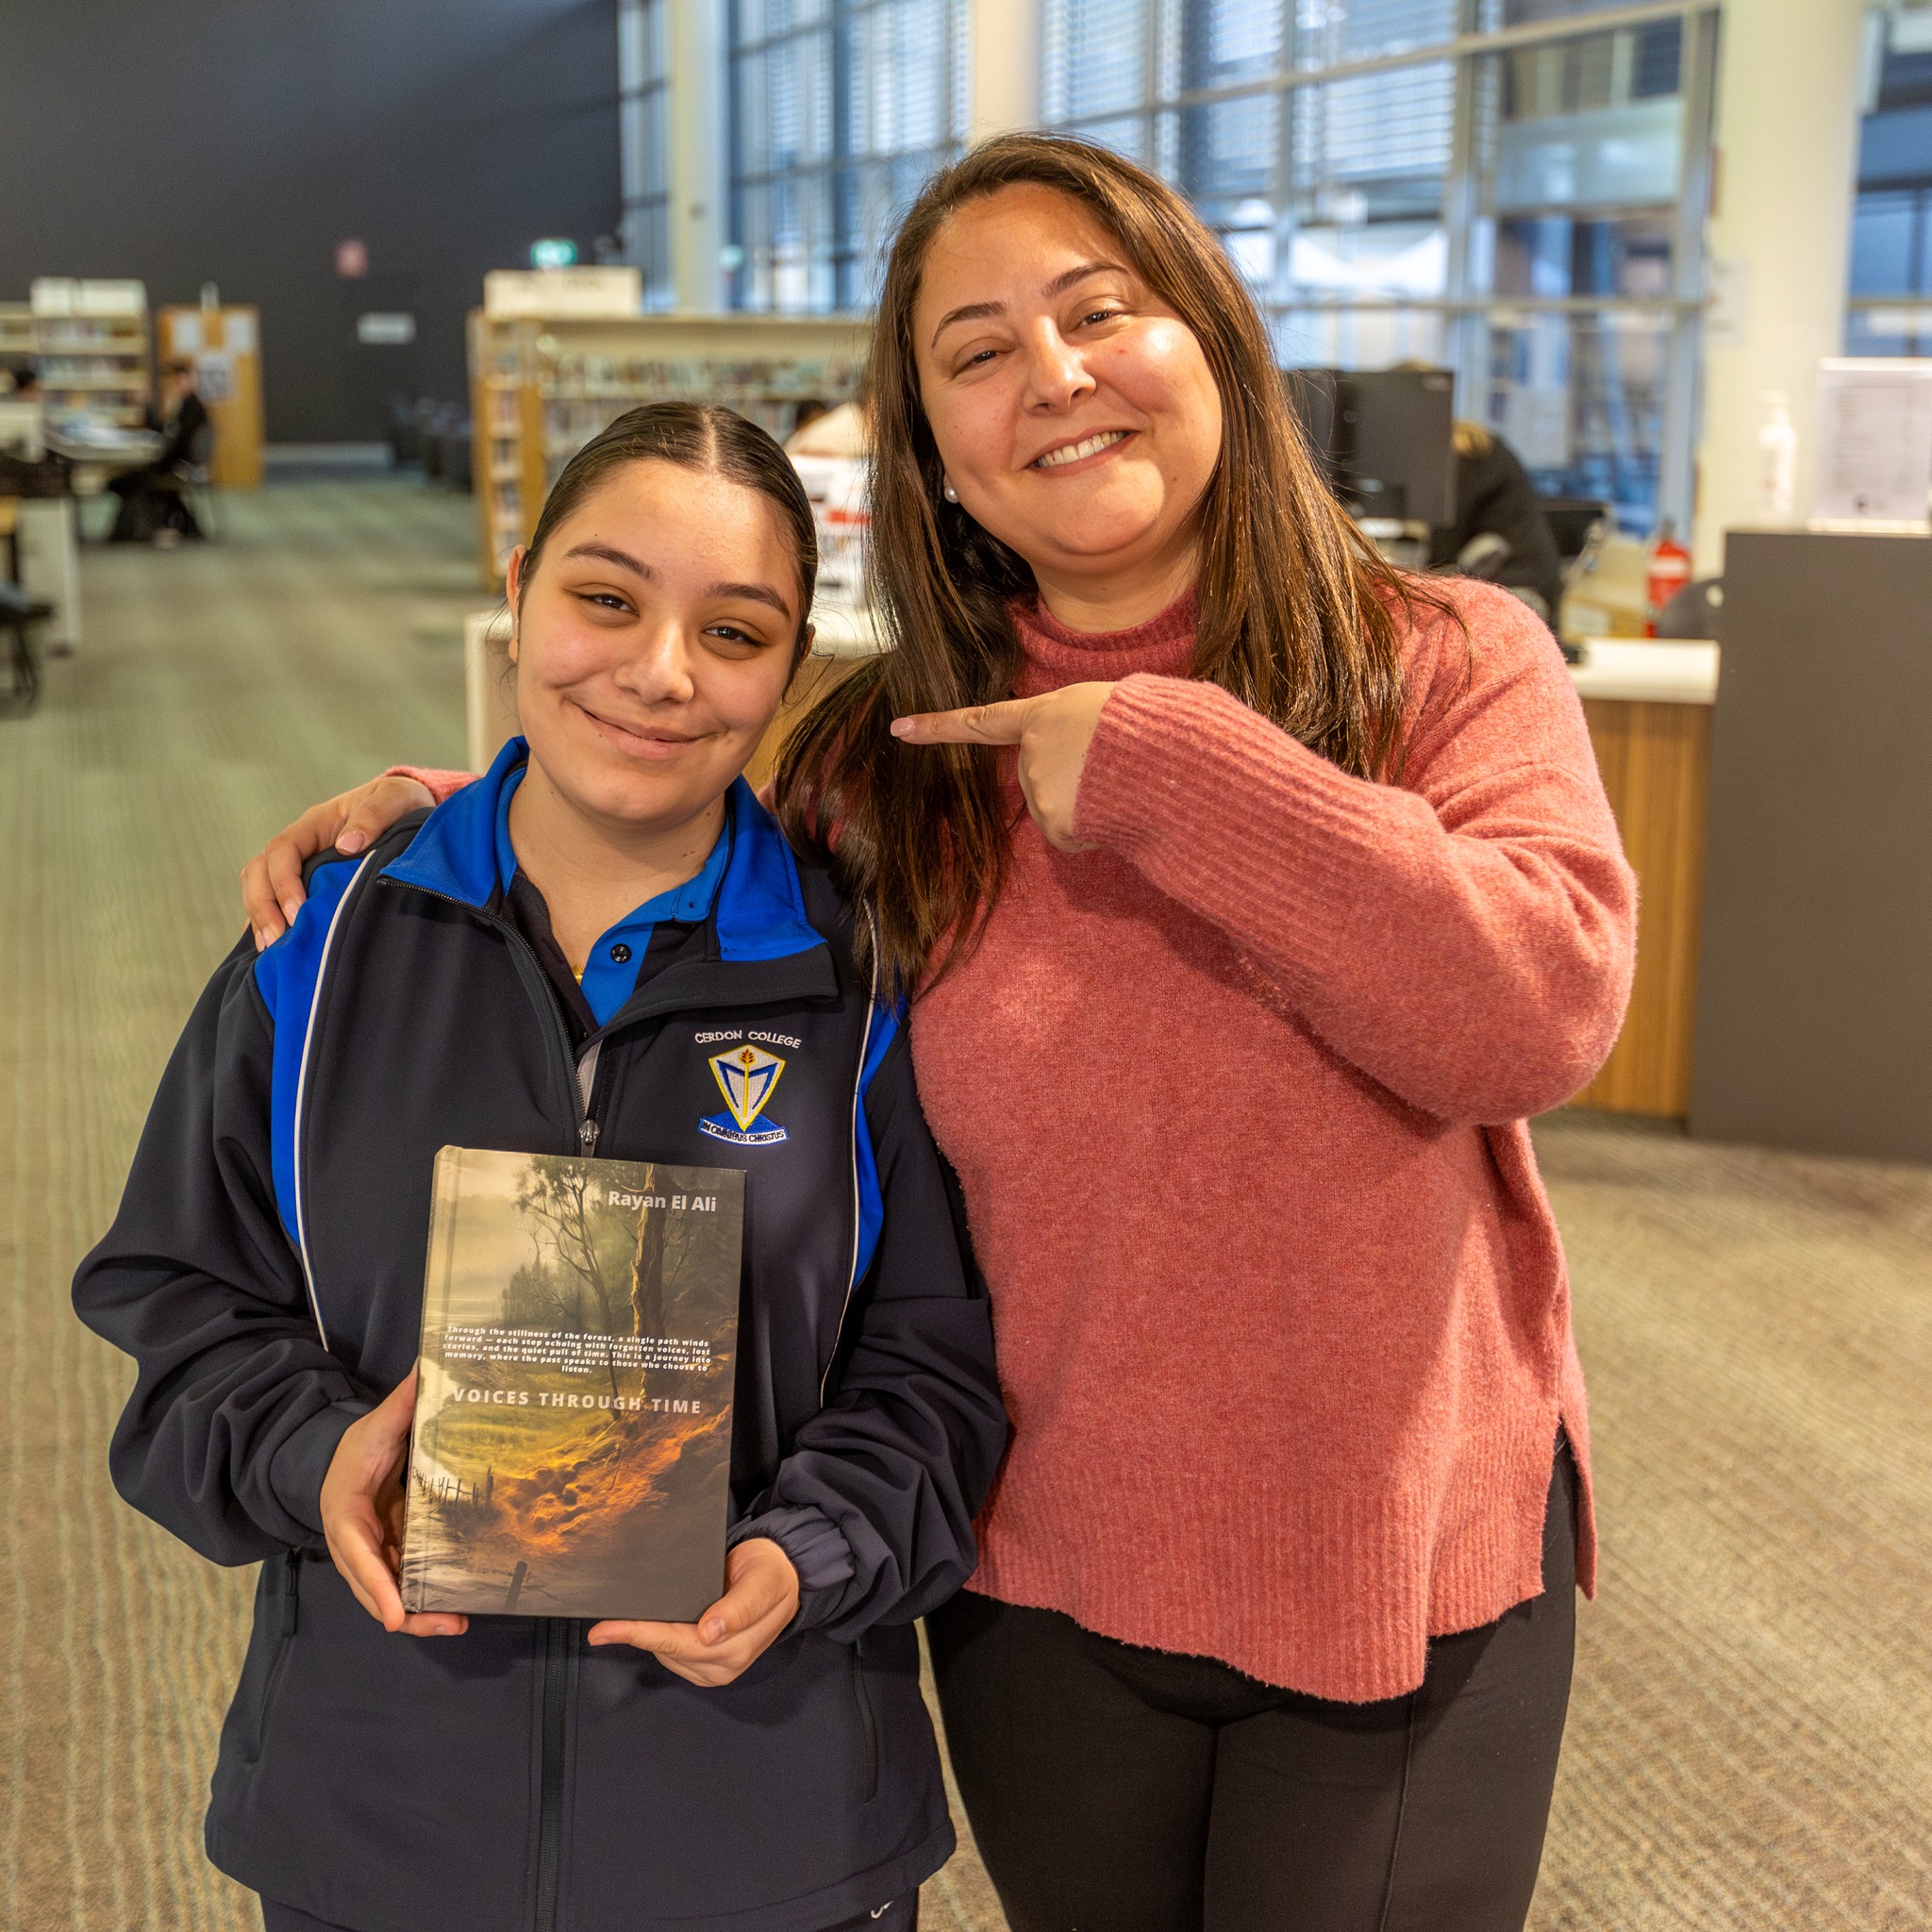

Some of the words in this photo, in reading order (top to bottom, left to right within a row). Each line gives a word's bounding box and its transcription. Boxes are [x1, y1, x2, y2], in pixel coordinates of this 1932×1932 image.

[694, 1029, 742, 1043] CERDON
[747, 1031, 802, 1049] COLLEGE
[748, 1130, 785, 1142] CHRISTUS
[608, 1191, 666, 1210] Rayan
[671, 1194, 687, 1209] El
[691, 1196, 717, 1211] Ali
[447, 1325, 486, 1336] Through
[508, 1330, 549, 1339] stillness
[583, 1333, 615, 1342] forest,
[442, 1342, 479, 1352] stories,
[521, 1346, 546, 1355] quiet
[549, 1348, 568, 1357] pull
[611, 1351, 630, 1359] This
[653, 1354, 690, 1363] journey
[444, 1334, 482, 1342] forward
[521, 1339, 542, 1347] step
[544, 1340, 582, 1349] echoing
[608, 1343, 654, 1352] forgotten
[657, 1345, 690, 1355] voices,
[692, 1347, 710, 1356] lost
[444, 1351, 486, 1360] memory,
[490, 1353, 518, 1361] where
[540, 1356, 561, 1364] past
[563, 1357, 596, 1366] speaks
[561, 1364, 592, 1374] listen.
[453, 1388, 529, 1406] VOICES
[539, 1392, 642, 1411] THROUGH
[651, 1398, 701, 1414] TIME
